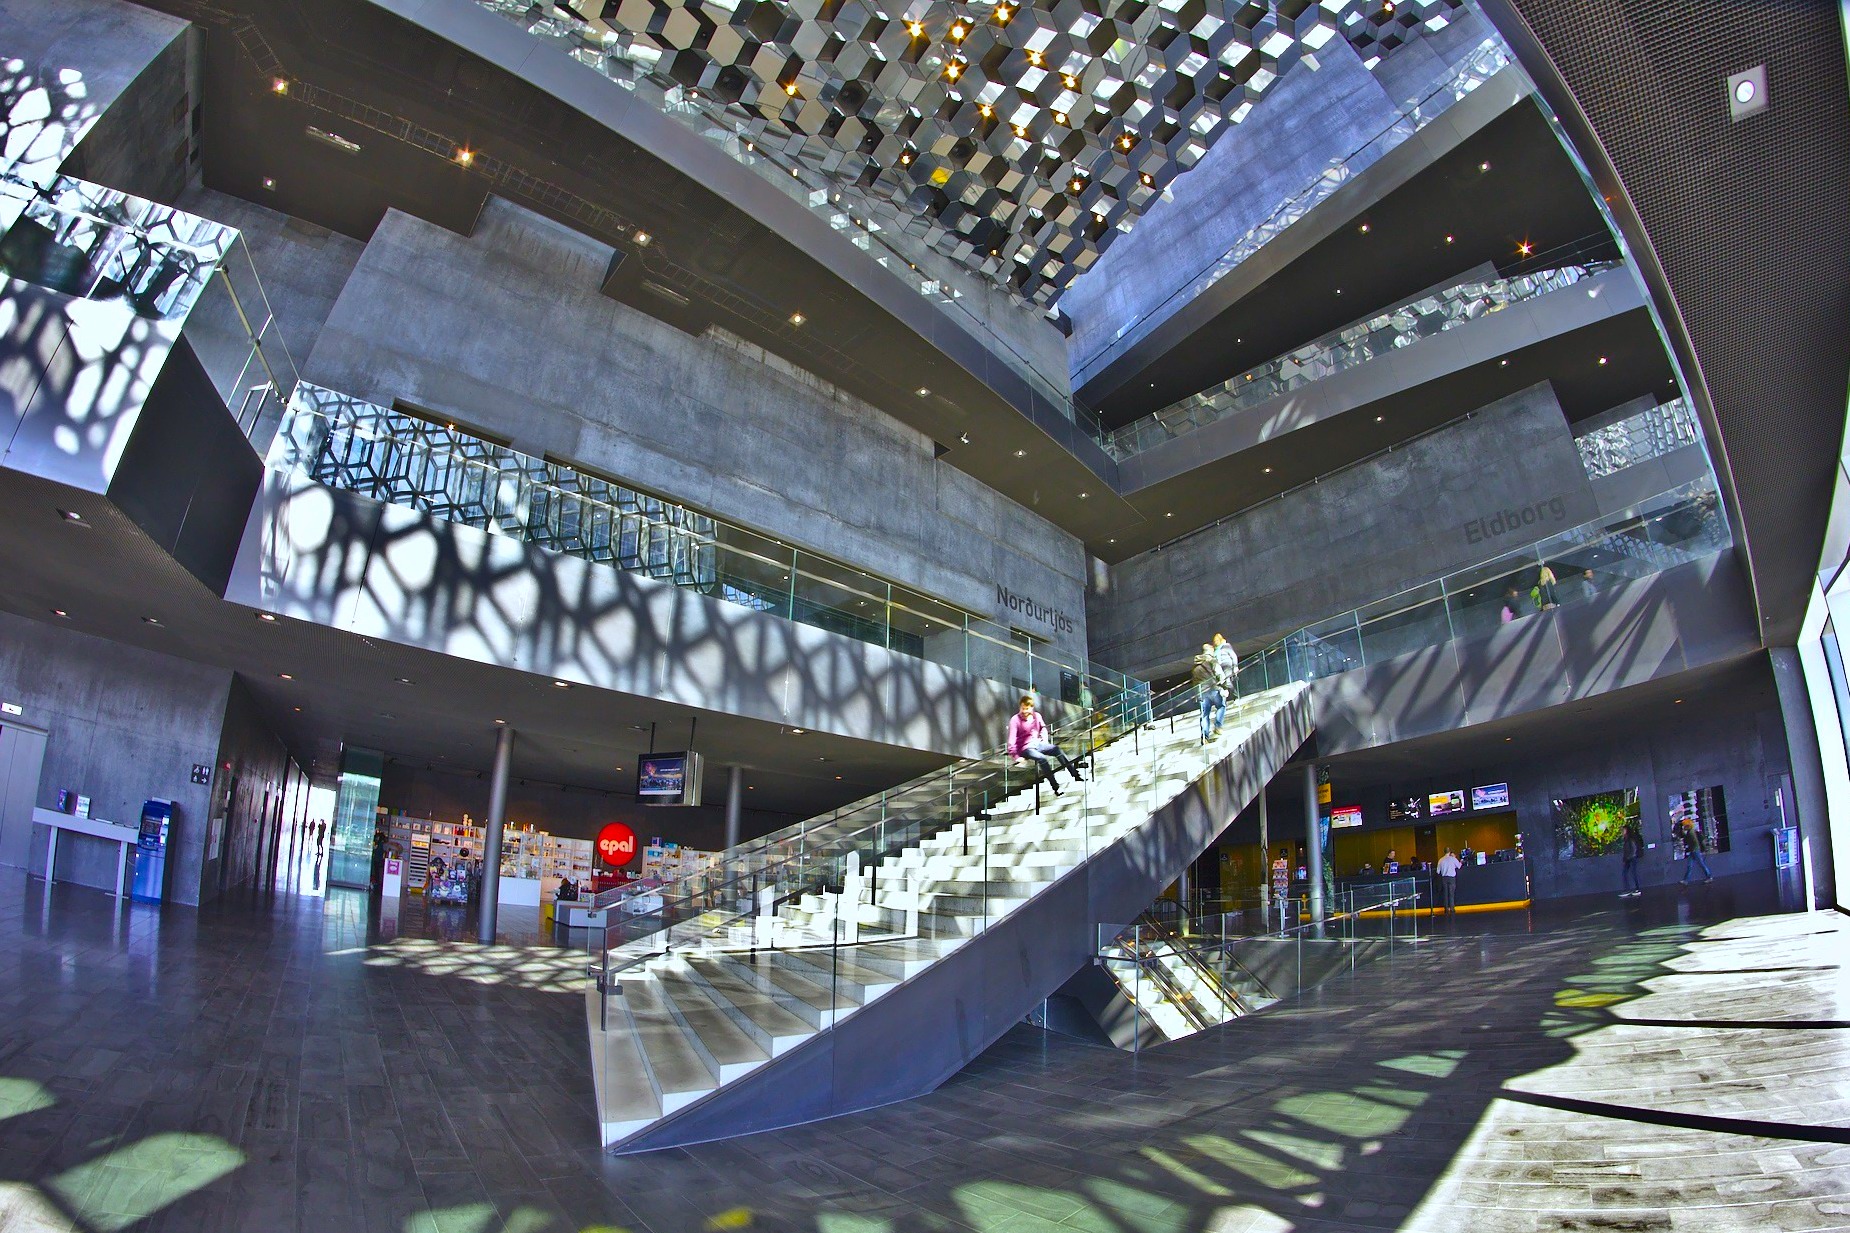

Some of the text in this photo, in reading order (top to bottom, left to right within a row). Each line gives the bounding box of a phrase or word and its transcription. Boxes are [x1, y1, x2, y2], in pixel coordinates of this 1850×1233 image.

[1464, 496, 1566, 545] Eldborg
[996, 583, 1073, 634] Norðurljós
[599, 835, 633, 856] epal
